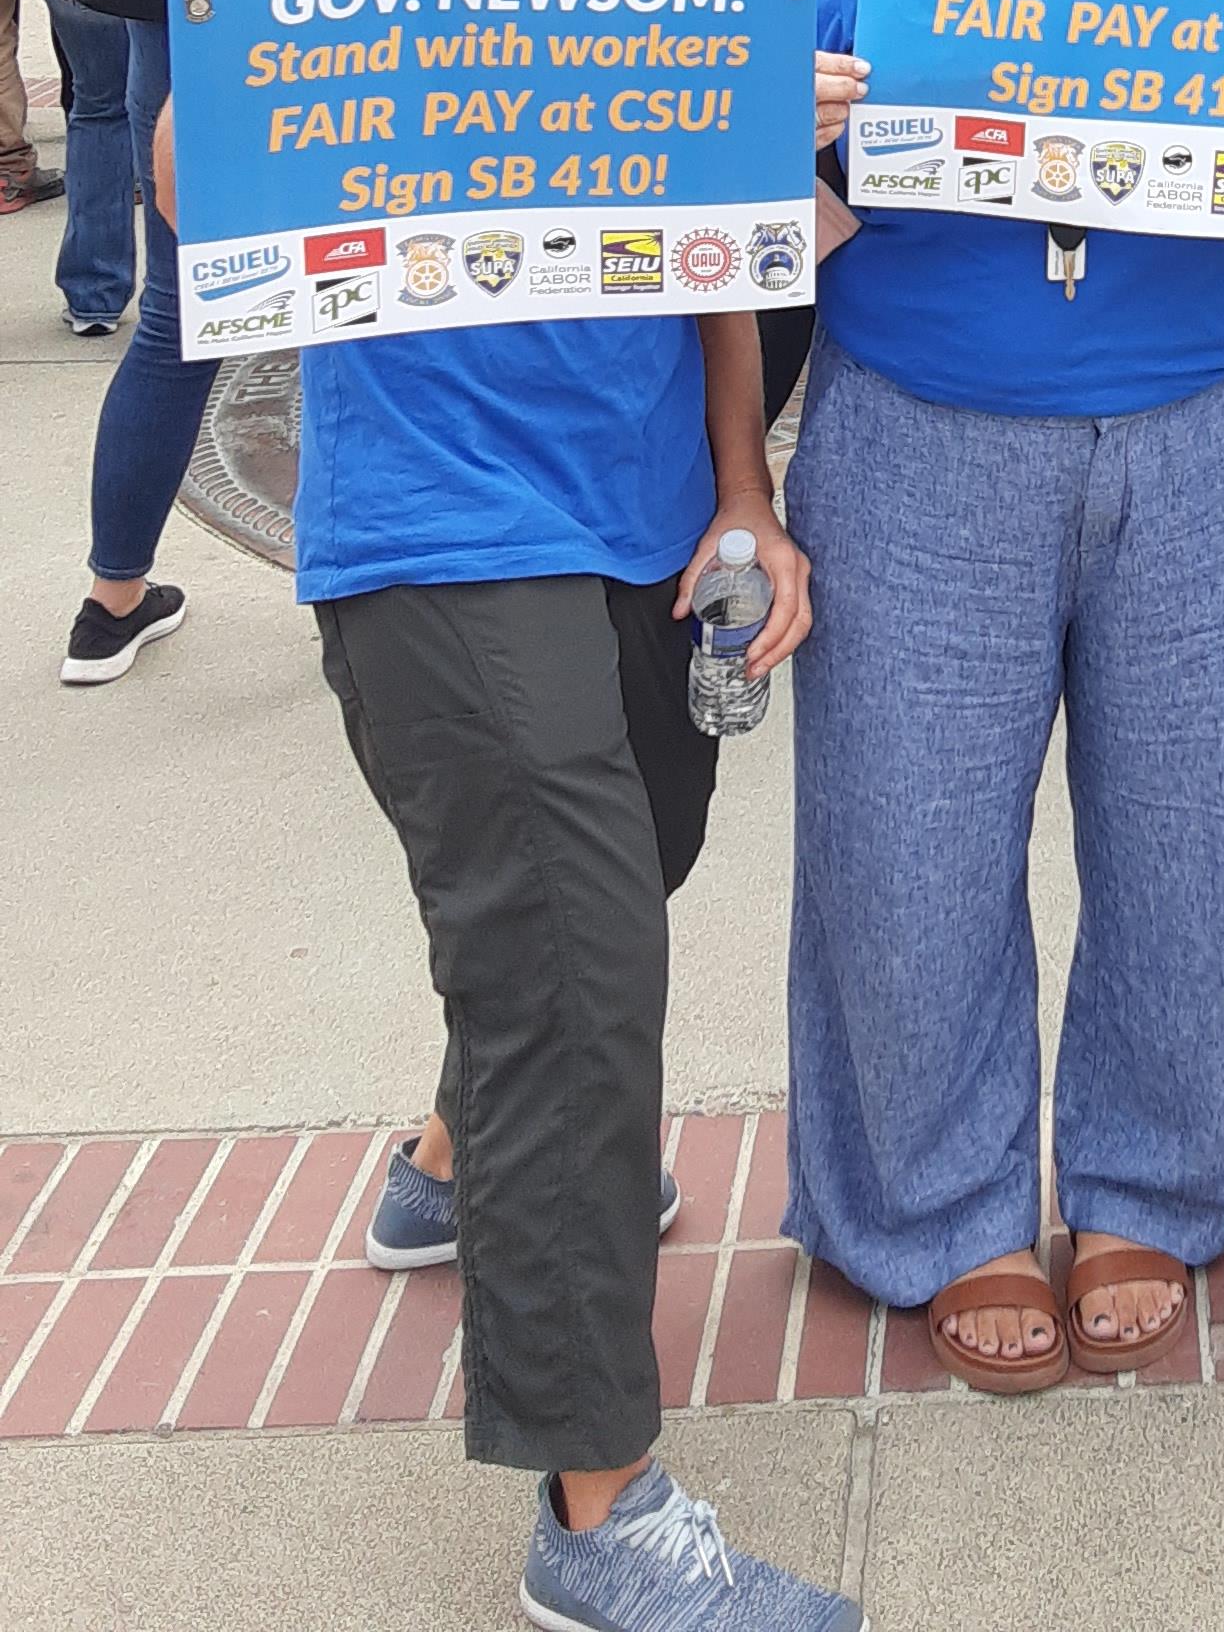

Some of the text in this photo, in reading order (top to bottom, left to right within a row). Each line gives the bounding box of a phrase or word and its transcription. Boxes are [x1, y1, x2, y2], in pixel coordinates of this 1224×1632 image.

[1066, 1, 1169, 49] PAY
[1172, 12, 1223, 54] at
[245, 22, 751, 88] Stand with workers
[987, 61, 1089, 117] Sign
[1099, 69, 1164, 114] SB
[268, 88, 732, 153] FAIR PAY at CSU!
[859, 118, 934, 139] CSUEU
[984, 128, 1009, 142] CFA
[339, 153, 668, 217] Sign SB 410!
[861, 173, 942, 191] AFSCME
[963, 166, 1011, 195] apc
[1095, 169, 1136, 184] SUPA
[1147, 178, 1204, 191] California
[1146, 188, 1203, 203] LABOR
[1146, 199, 1203, 212] Federation
[339, 240, 367, 255] CFA
[192, 244, 280, 283] CSUEU
[603, 256, 661, 273] SEIU
[691, 251, 721, 268] UAW
[470, 261, 515, 276] SUPA
[529, 264, 592, 275] California
[529, 273, 592, 287] LABOR
[529, 286, 592, 296] Federation
[319, 280, 373, 321] apc
[196, 310, 294, 339] AFSCME
